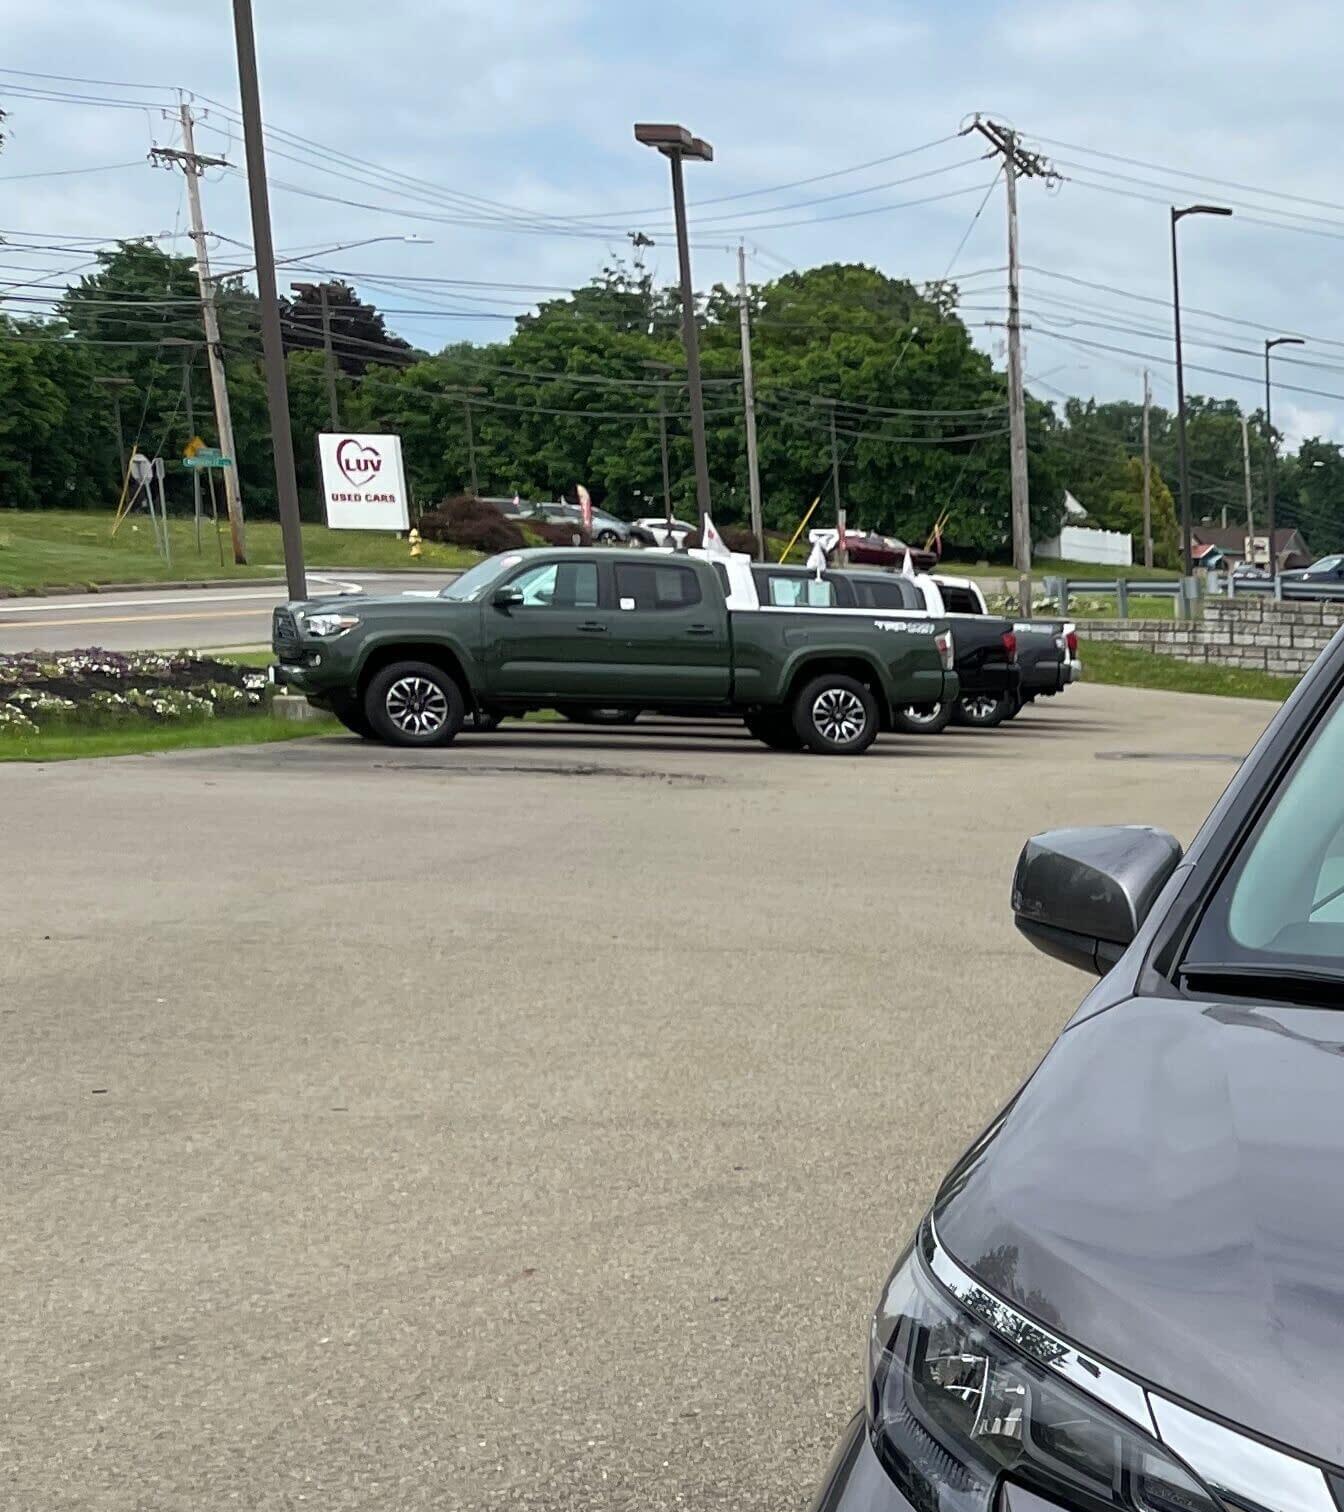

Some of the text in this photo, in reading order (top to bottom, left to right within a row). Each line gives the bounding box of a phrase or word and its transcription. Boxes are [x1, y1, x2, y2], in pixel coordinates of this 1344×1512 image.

[344, 458, 382, 472] LUV
[331, 493, 396, 504] USED CARS
